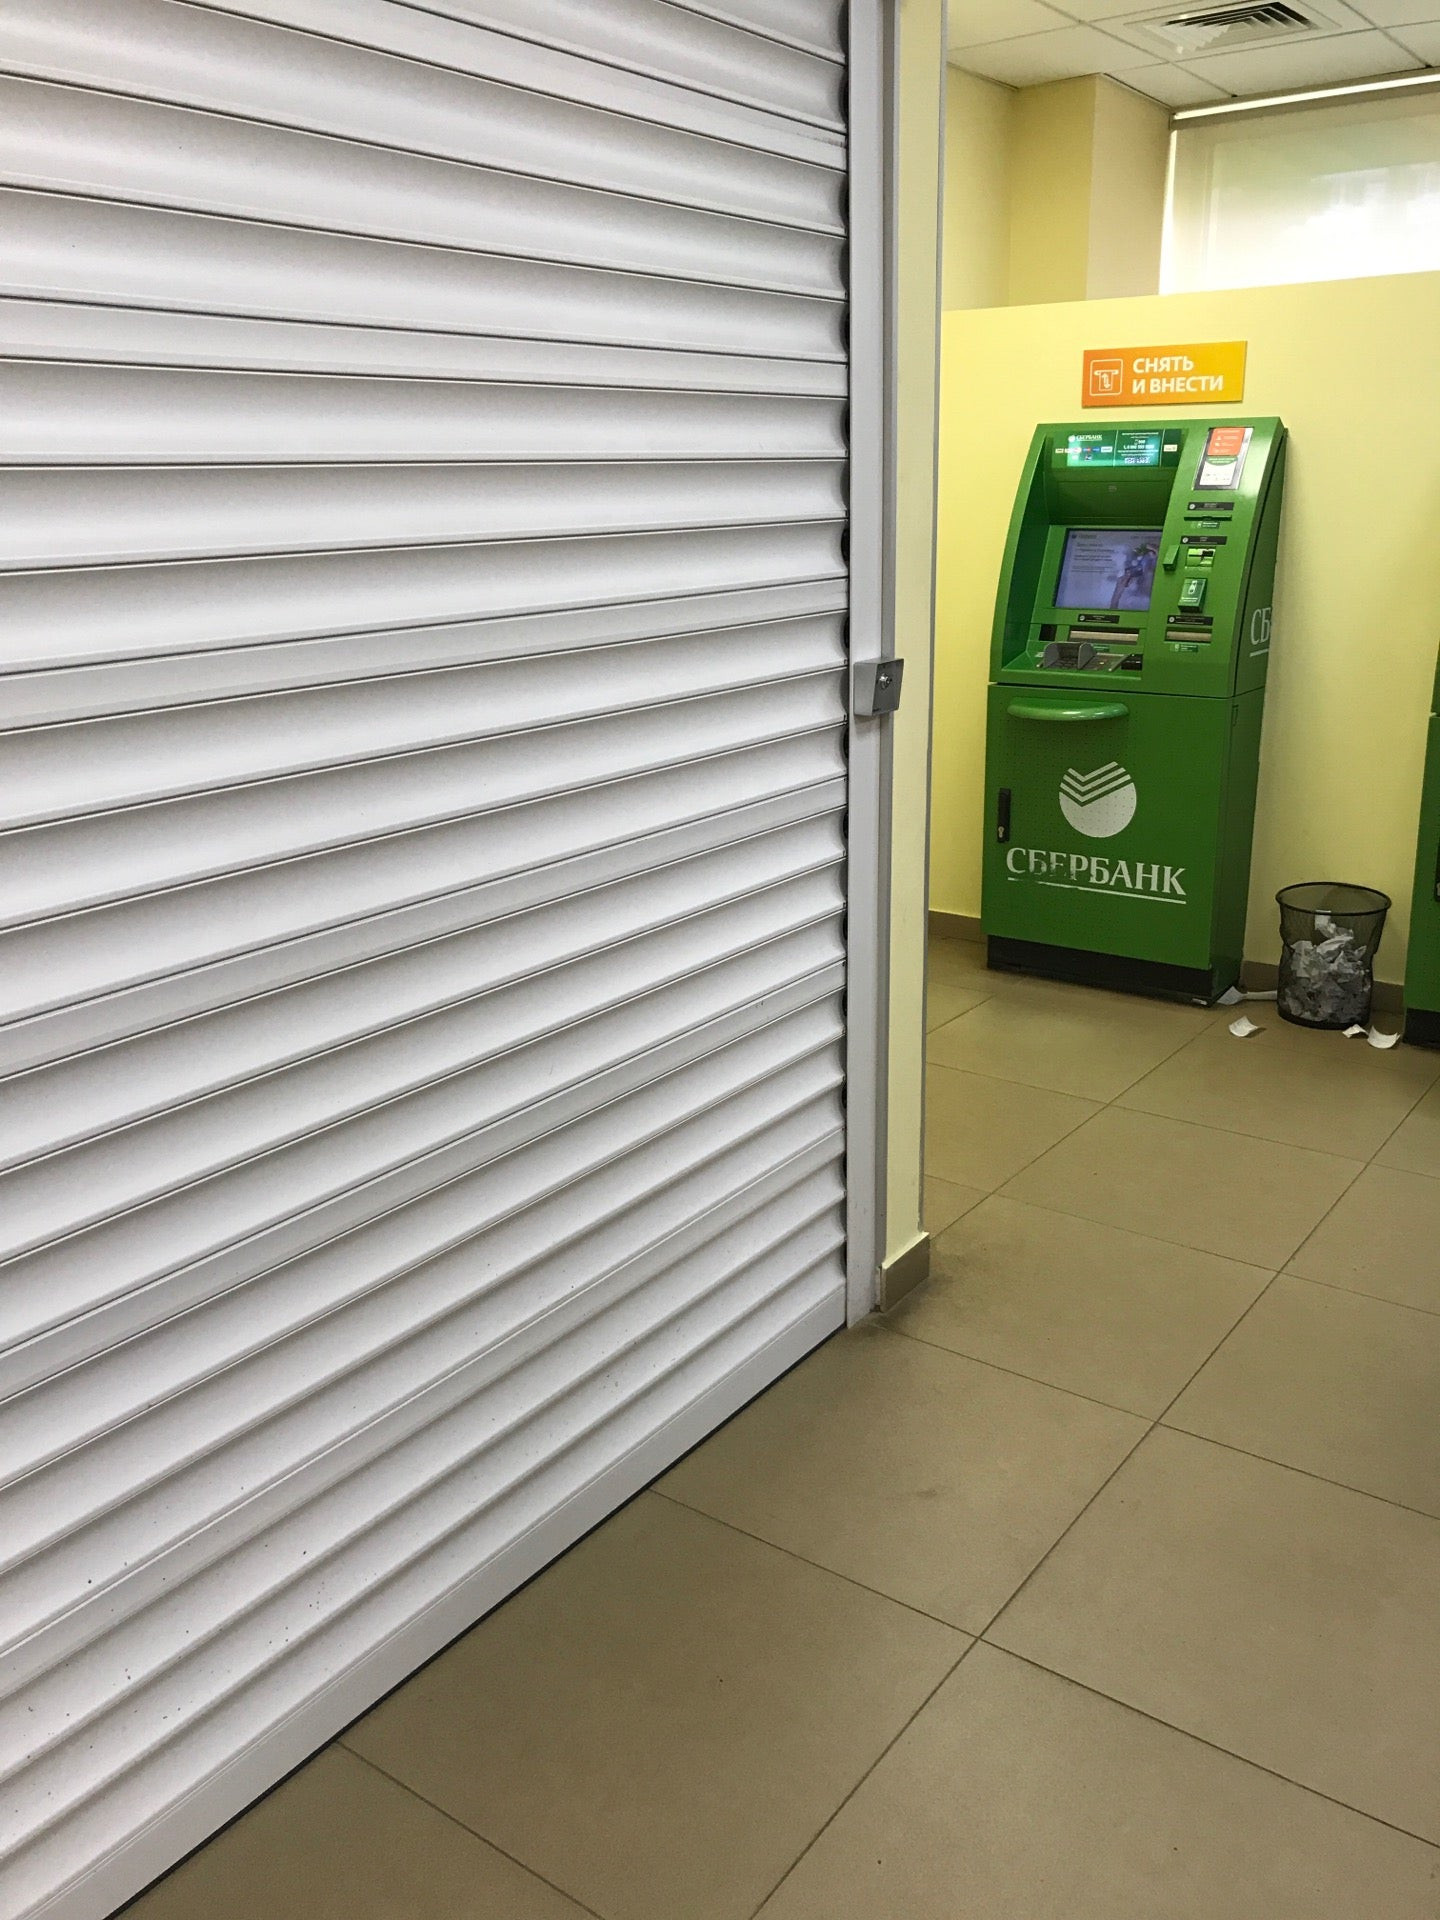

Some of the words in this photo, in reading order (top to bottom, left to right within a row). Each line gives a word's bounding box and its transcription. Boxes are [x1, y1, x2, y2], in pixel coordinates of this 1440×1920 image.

[1132, 356, 1195, 374] СНЯТЬ
[1132, 378, 1146, 395] И
[1149, 375, 1224, 394] ВНЕСТИ
[1006, 847, 1187, 896] СБЕРБАНК
